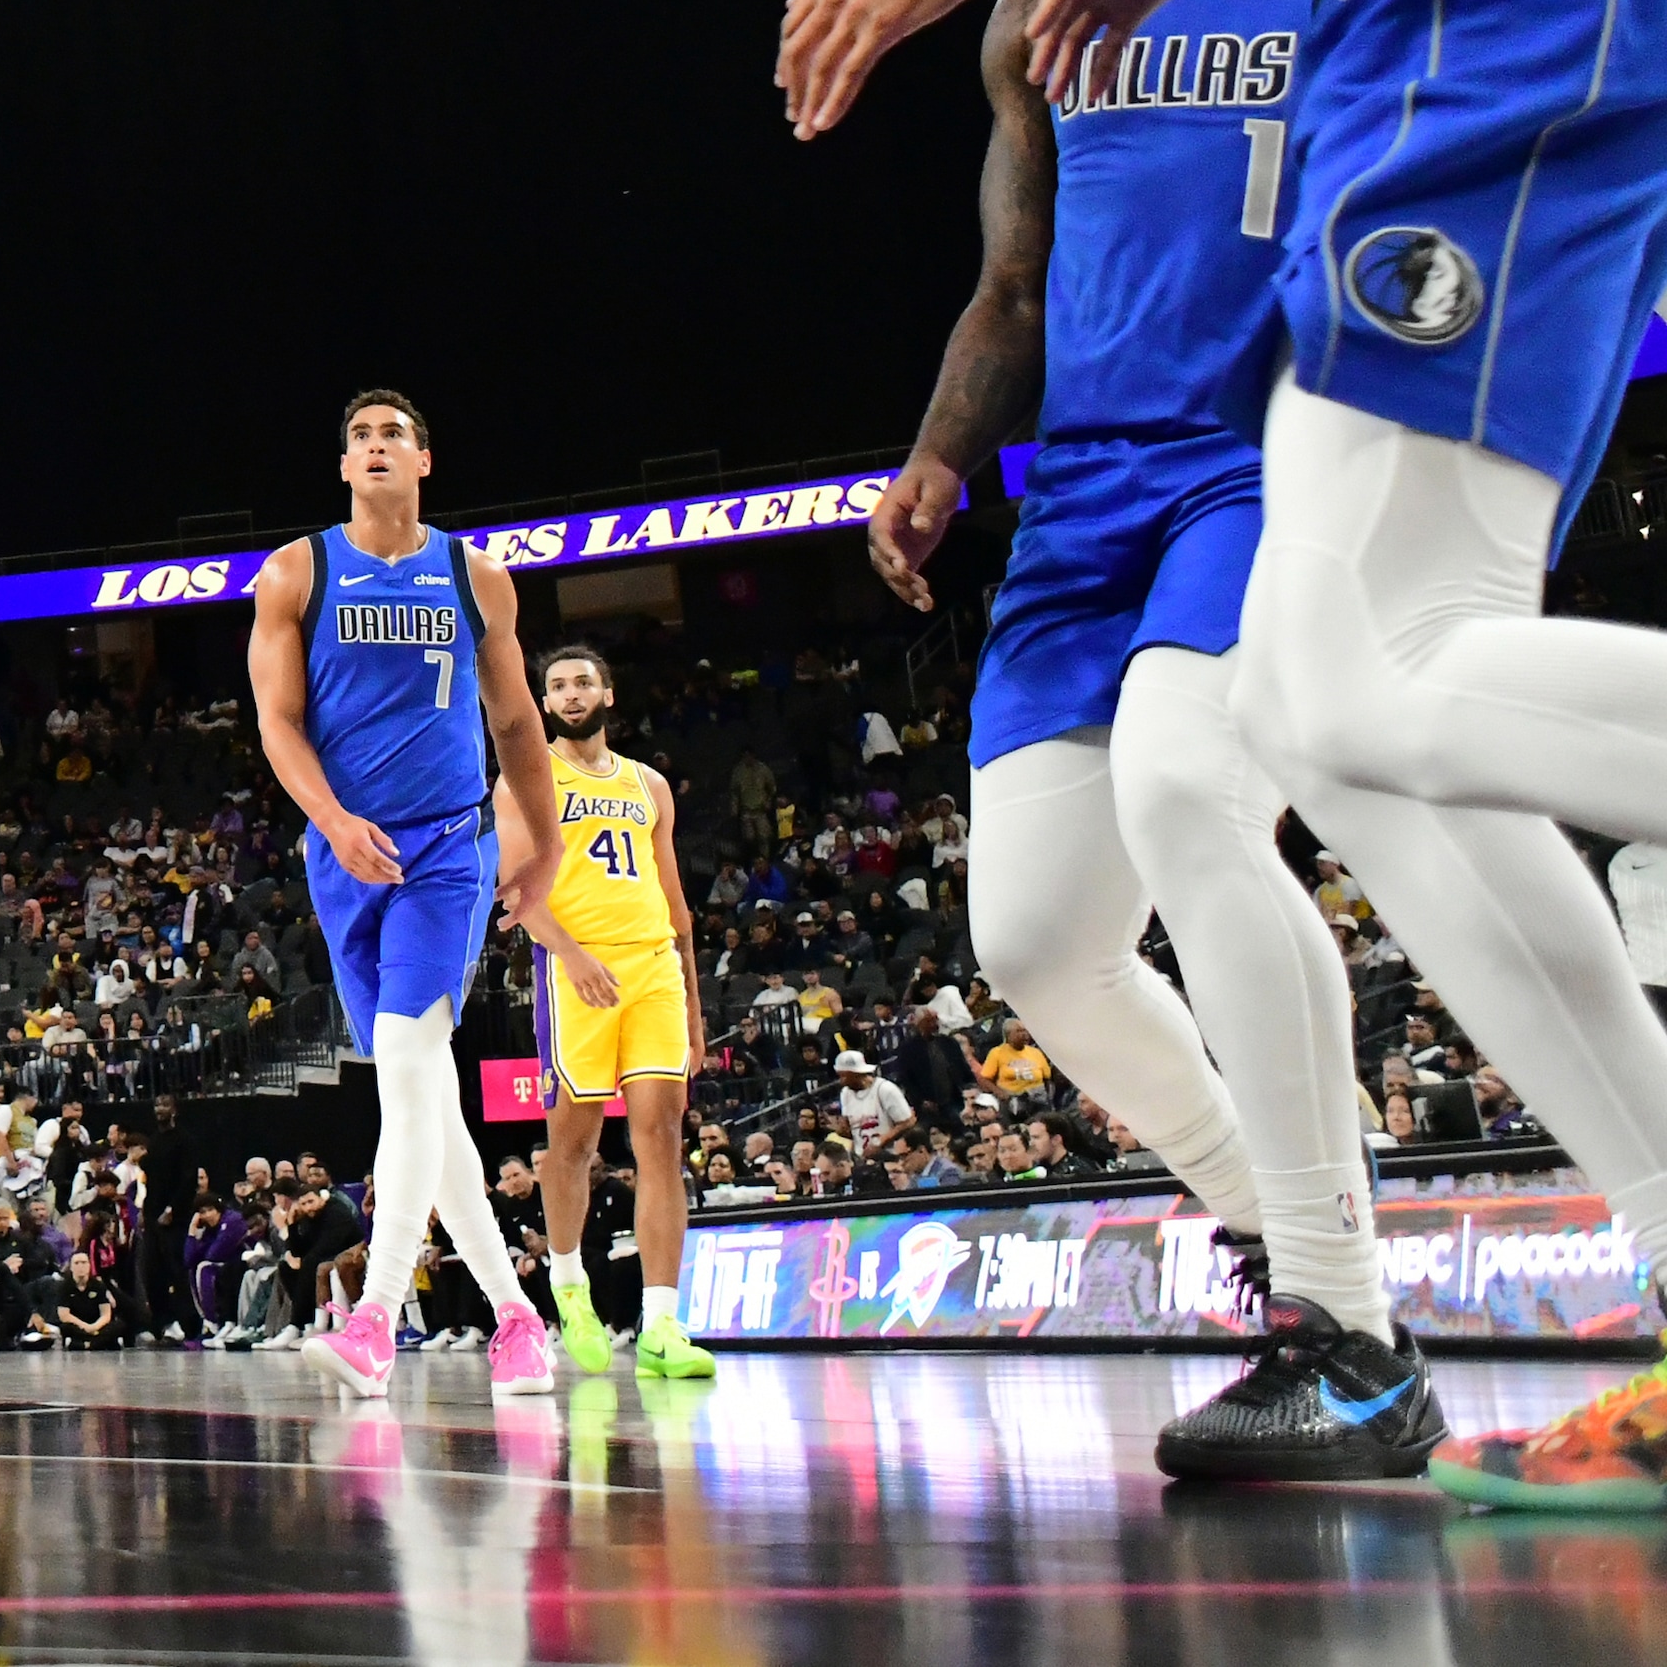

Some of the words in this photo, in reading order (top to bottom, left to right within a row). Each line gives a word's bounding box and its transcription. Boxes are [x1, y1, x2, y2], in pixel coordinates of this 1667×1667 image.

[1240, 118, 1286, 239] 1
[579, 475, 890, 557] LAKERS
[91, 560, 230, 608] LOS
[413, 573, 451, 586] chime
[336, 604, 457, 645] DALLAS
[424, 649, 454, 709] 7
[558, 791, 647, 825] LAKERS
[587, 828, 640, 880] 41
[1376, 1233, 1455, 1284] NBC
[1473, 1211, 1639, 1302] peacock
